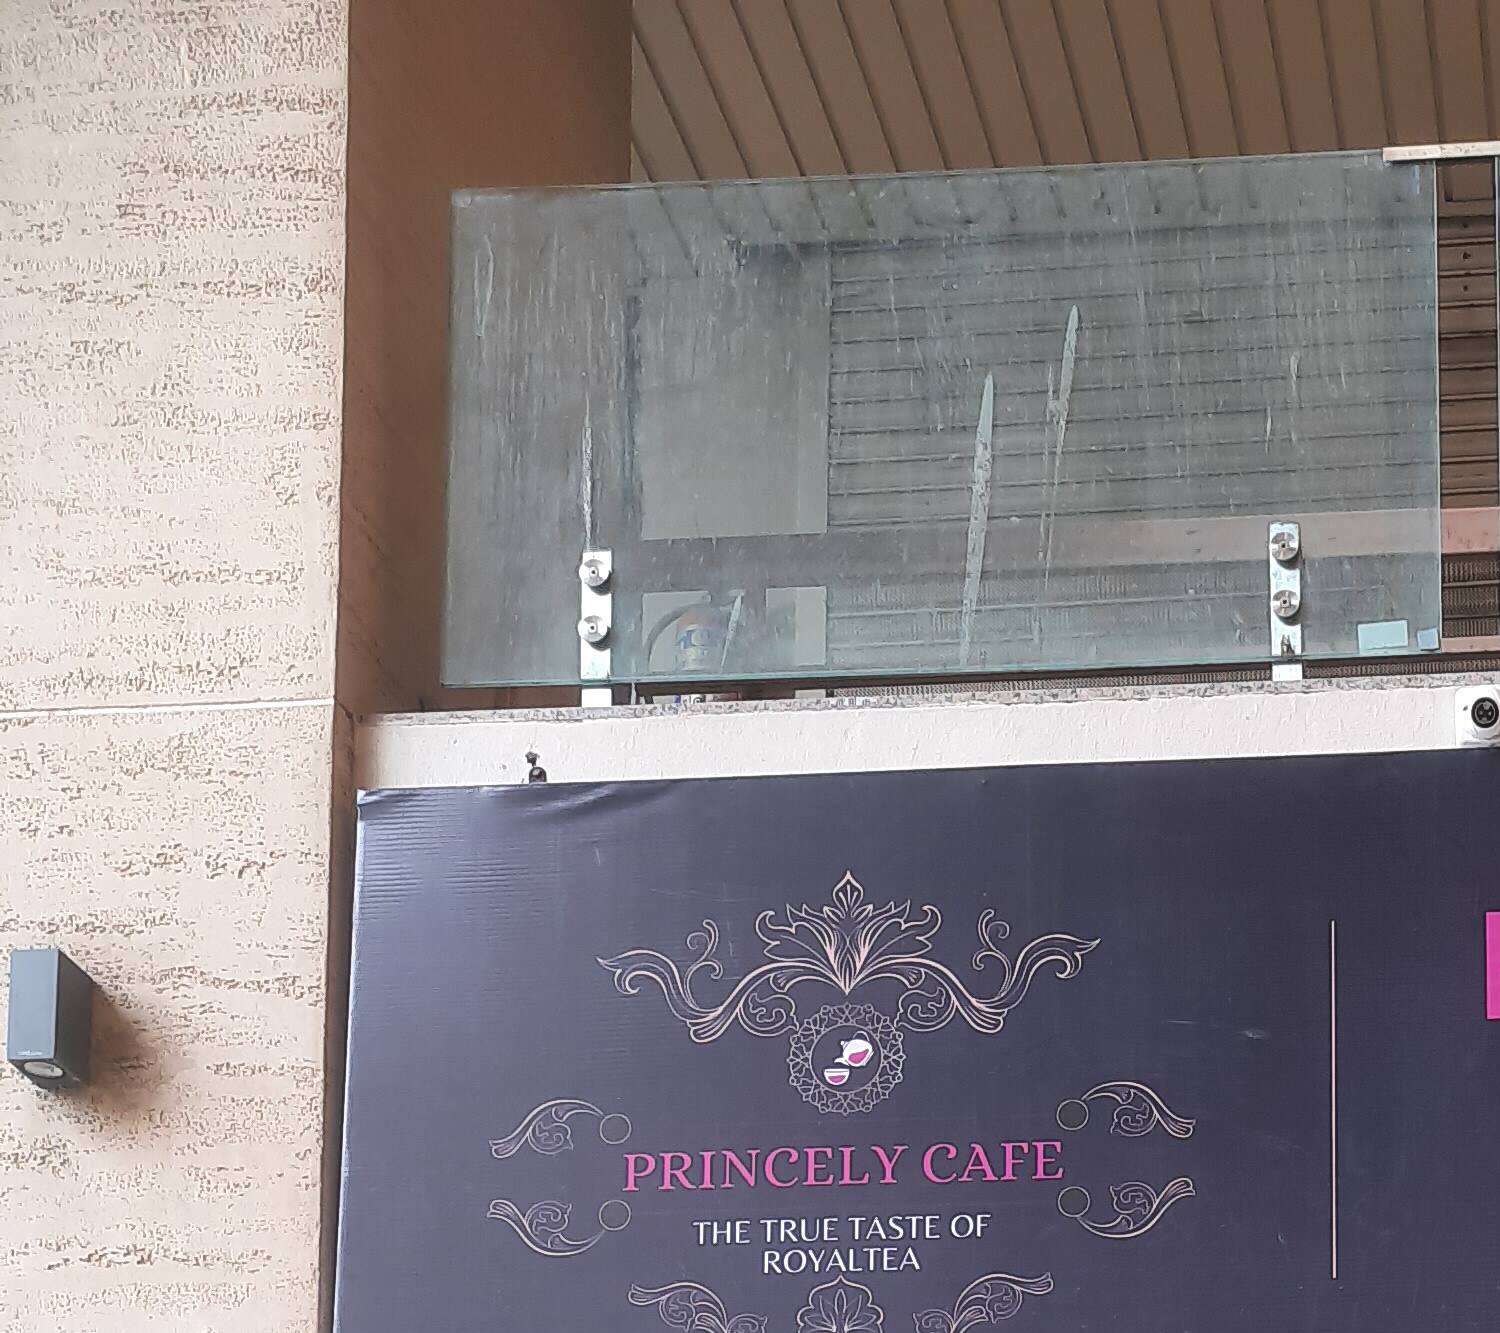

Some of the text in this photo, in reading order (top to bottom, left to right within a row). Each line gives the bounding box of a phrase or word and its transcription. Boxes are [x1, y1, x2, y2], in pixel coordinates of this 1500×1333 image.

[622, 1140, 1066, 1192] PRINCELY CAFE
[693, 1213, 993, 1246] THE TRUE TASTE OF
[762, 1246, 922, 1275] ROYALTEA
